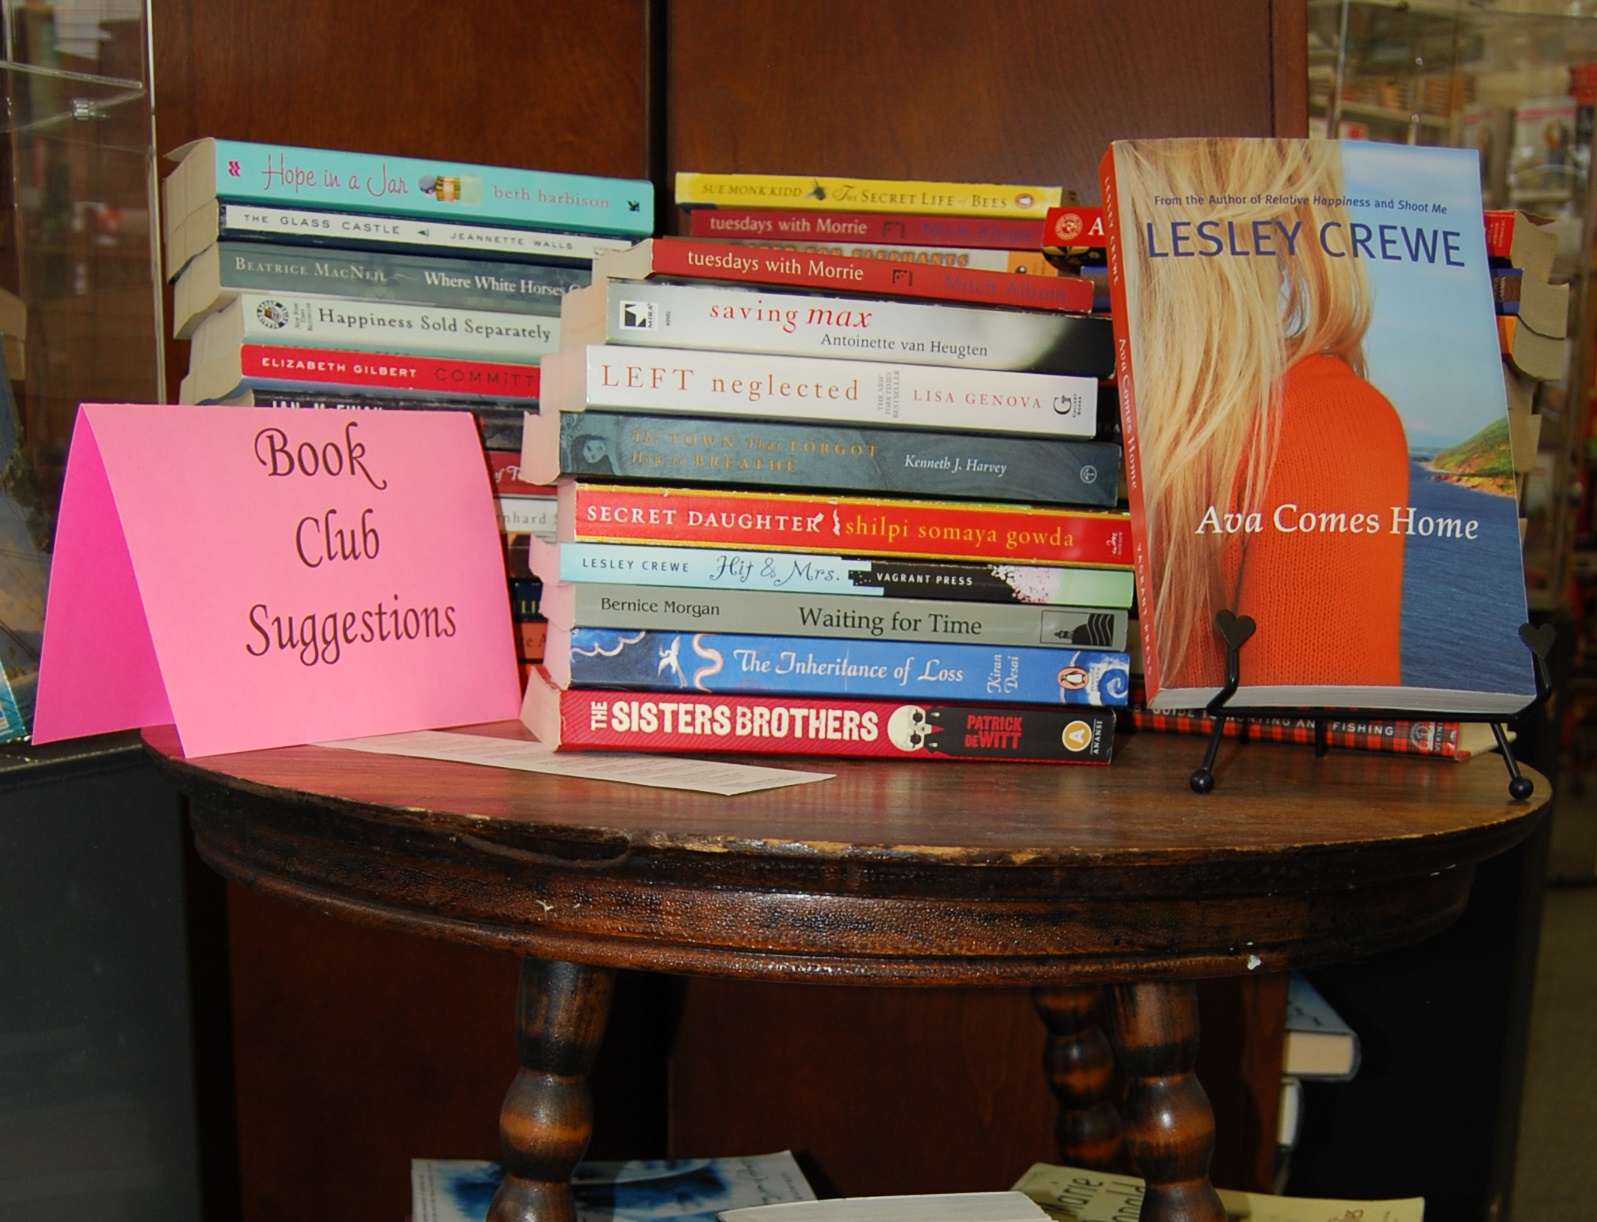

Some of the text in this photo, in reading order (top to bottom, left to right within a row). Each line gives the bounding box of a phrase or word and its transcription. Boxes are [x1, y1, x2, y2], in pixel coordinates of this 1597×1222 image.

[261, 152, 408, 197] Hope in a Jar
[494, 185, 610, 208] beth harbison
[702, 184, 802, 198] SUE MONK KIDD
[861, 189, 1008, 209] SECRET LIFE BEES
[1154, 194, 1448, 215] From the Author of Relative Happiness and Shoot Me
[244, 214, 400, 235] THE GLASS CASTLE
[710, 216, 868, 235] tuesdays with Morrie
[450, 232, 573, 250] JEANNETTE WALLS
[1146, 220, 1303, 259] LESLEY
[1319, 221, 1466, 268] CREWE
[687, 250, 864, 281] tuesdays with Morrie
[424, 271, 471, 289] Where
[474, 275, 516, 293] White
[519, 279, 566, 296] Horses
[318, 307, 413, 329] Happiness
[420, 314, 458, 332] Sold
[464, 319, 551, 342] Separately
[710, 300, 873, 334] saving max
[821, 333, 988, 359] Antoinette van Heugten
[262, 357, 417, 378] ELIZABETH GILBERT
[601, 364, 858, 402] LEFT neglected
[913, 390, 1041, 409] LISA GENOVA
[254, 421, 387, 490] Book
[904, 454, 1007, 478] Kenneth Harvey
[587, 506, 822, 533] SECRET DAUGHTER
[845, 515, 1074, 550] shilpi somaya gowda
[1195, 503, 1479, 540] Ava Comes Home
[296, 508, 380, 568] Club
[582, 558, 689, 573] LESLEY CREWE
[876, 572, 973, 586] VAGRANT PRESS
[601, 598, 720, 618] Bernice Morgan
[799, 606, 982, 636] Waiting for Time
[246, 593, 457, 667] Suggestions
[733, 649, 963, 686] The Inheritance of Loss
[986, 654, 1002, 693] Kiran
[1004, 655, 1020, 694] Desai
[591, 701, 879, 742] THE SISTERS BROTHERS
[967, 714, 1023, 732] PATRICK
[1332, 721, 1394, 736] FISHING
[1093, 720, 1103, 755] ANANSI
